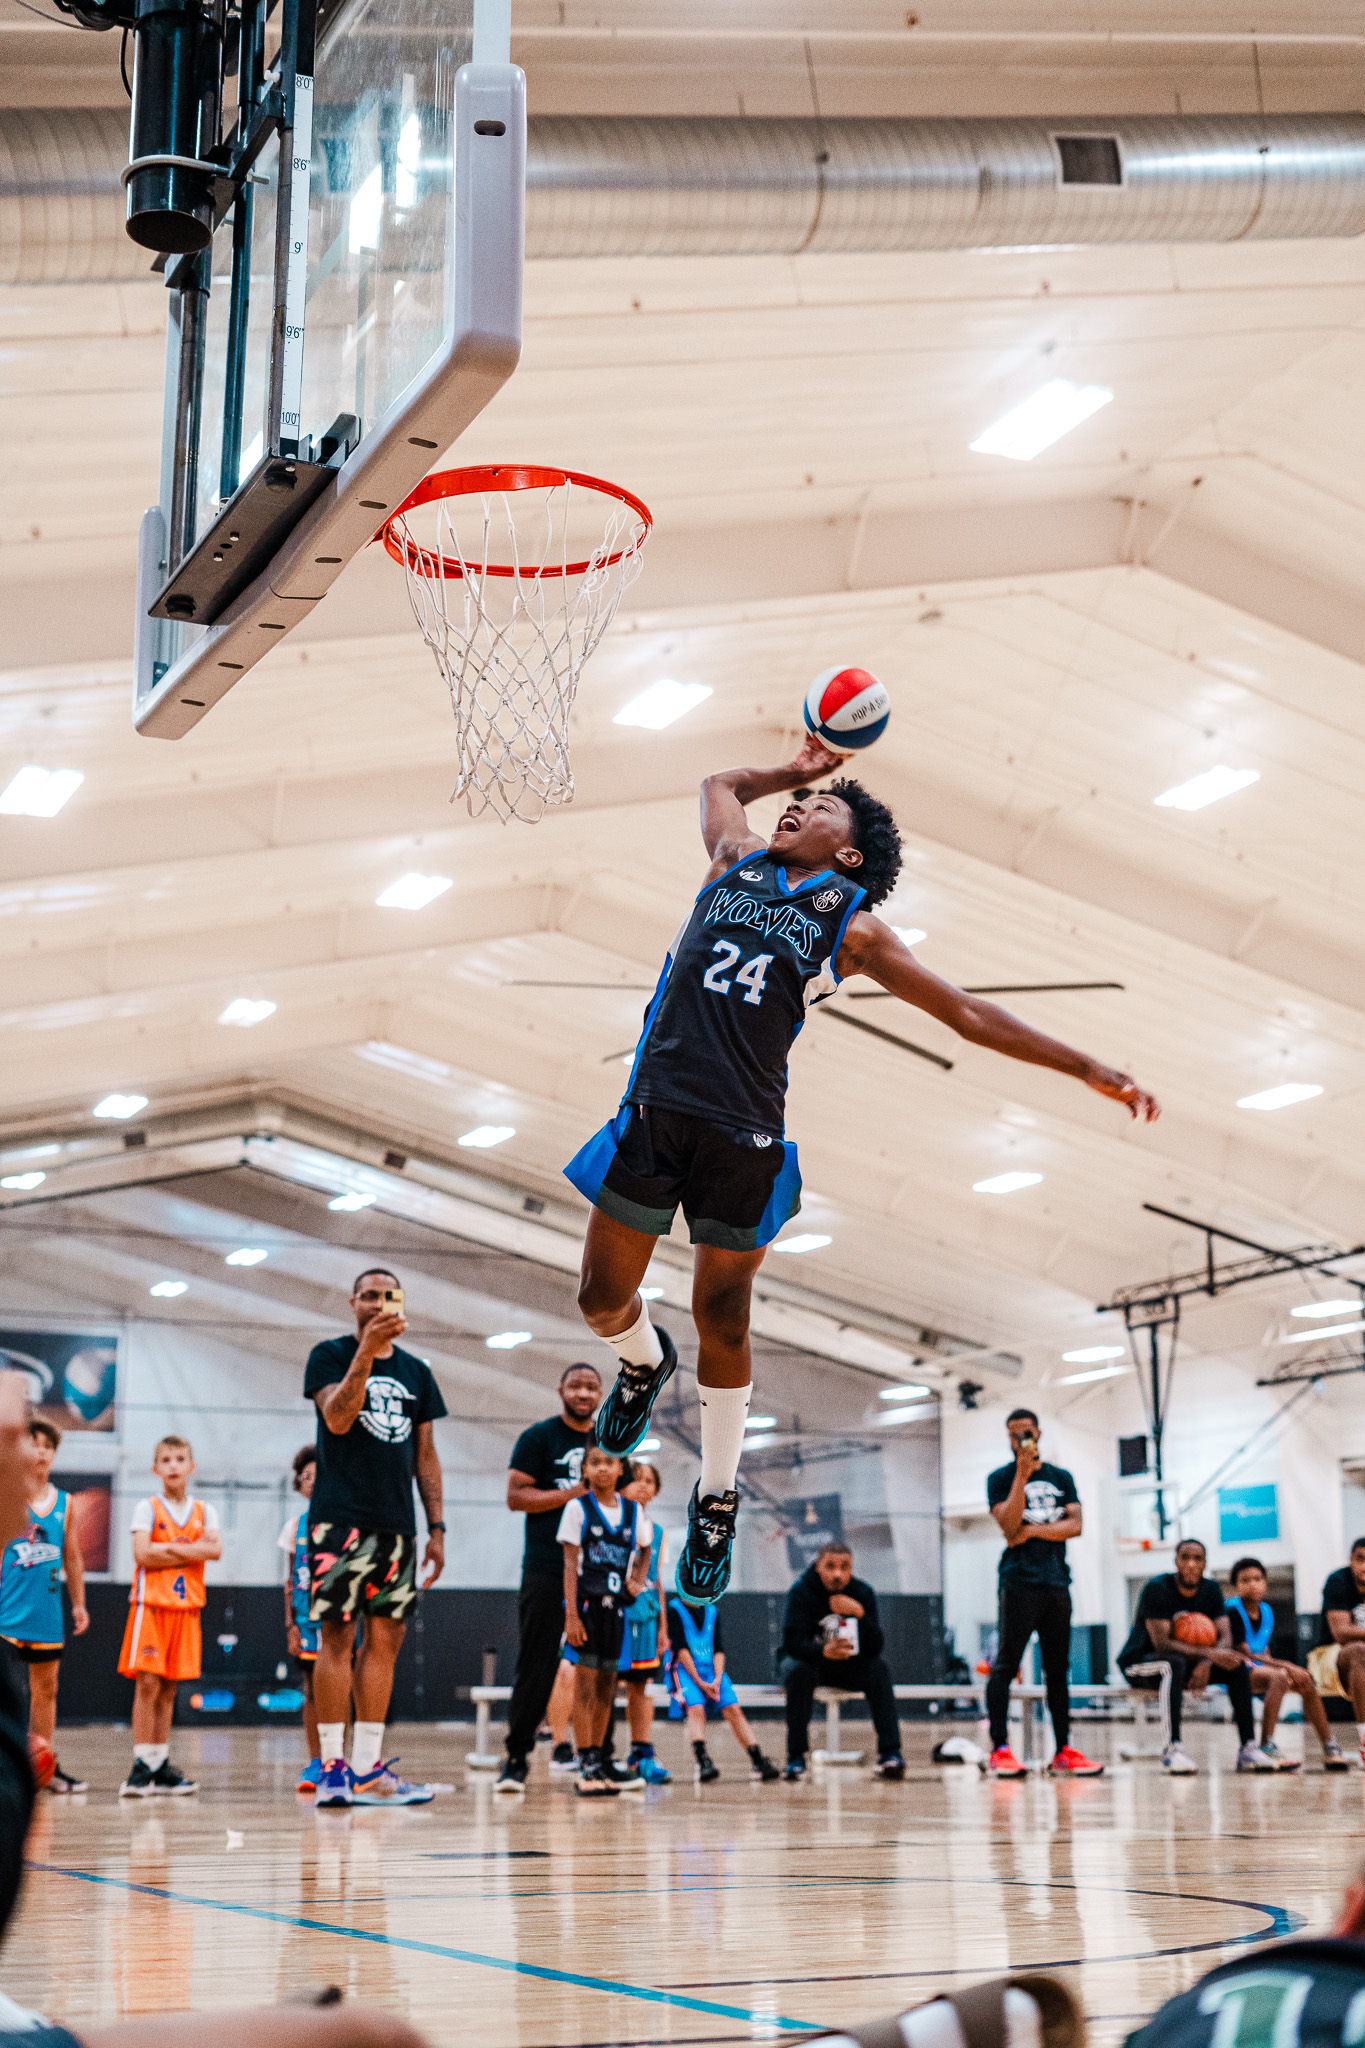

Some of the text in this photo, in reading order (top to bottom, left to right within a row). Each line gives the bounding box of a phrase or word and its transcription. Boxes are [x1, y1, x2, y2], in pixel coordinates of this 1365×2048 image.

[293, 157, 311, 171] 8'6"
[294, 241, 304, 254] 9'
[286, 325, 304, 339] 9'6"
[702, 887, 822, 959] WOLVES
[703, 938, 776, 1006] 24
[173, 1575, 186, 1600] 4
